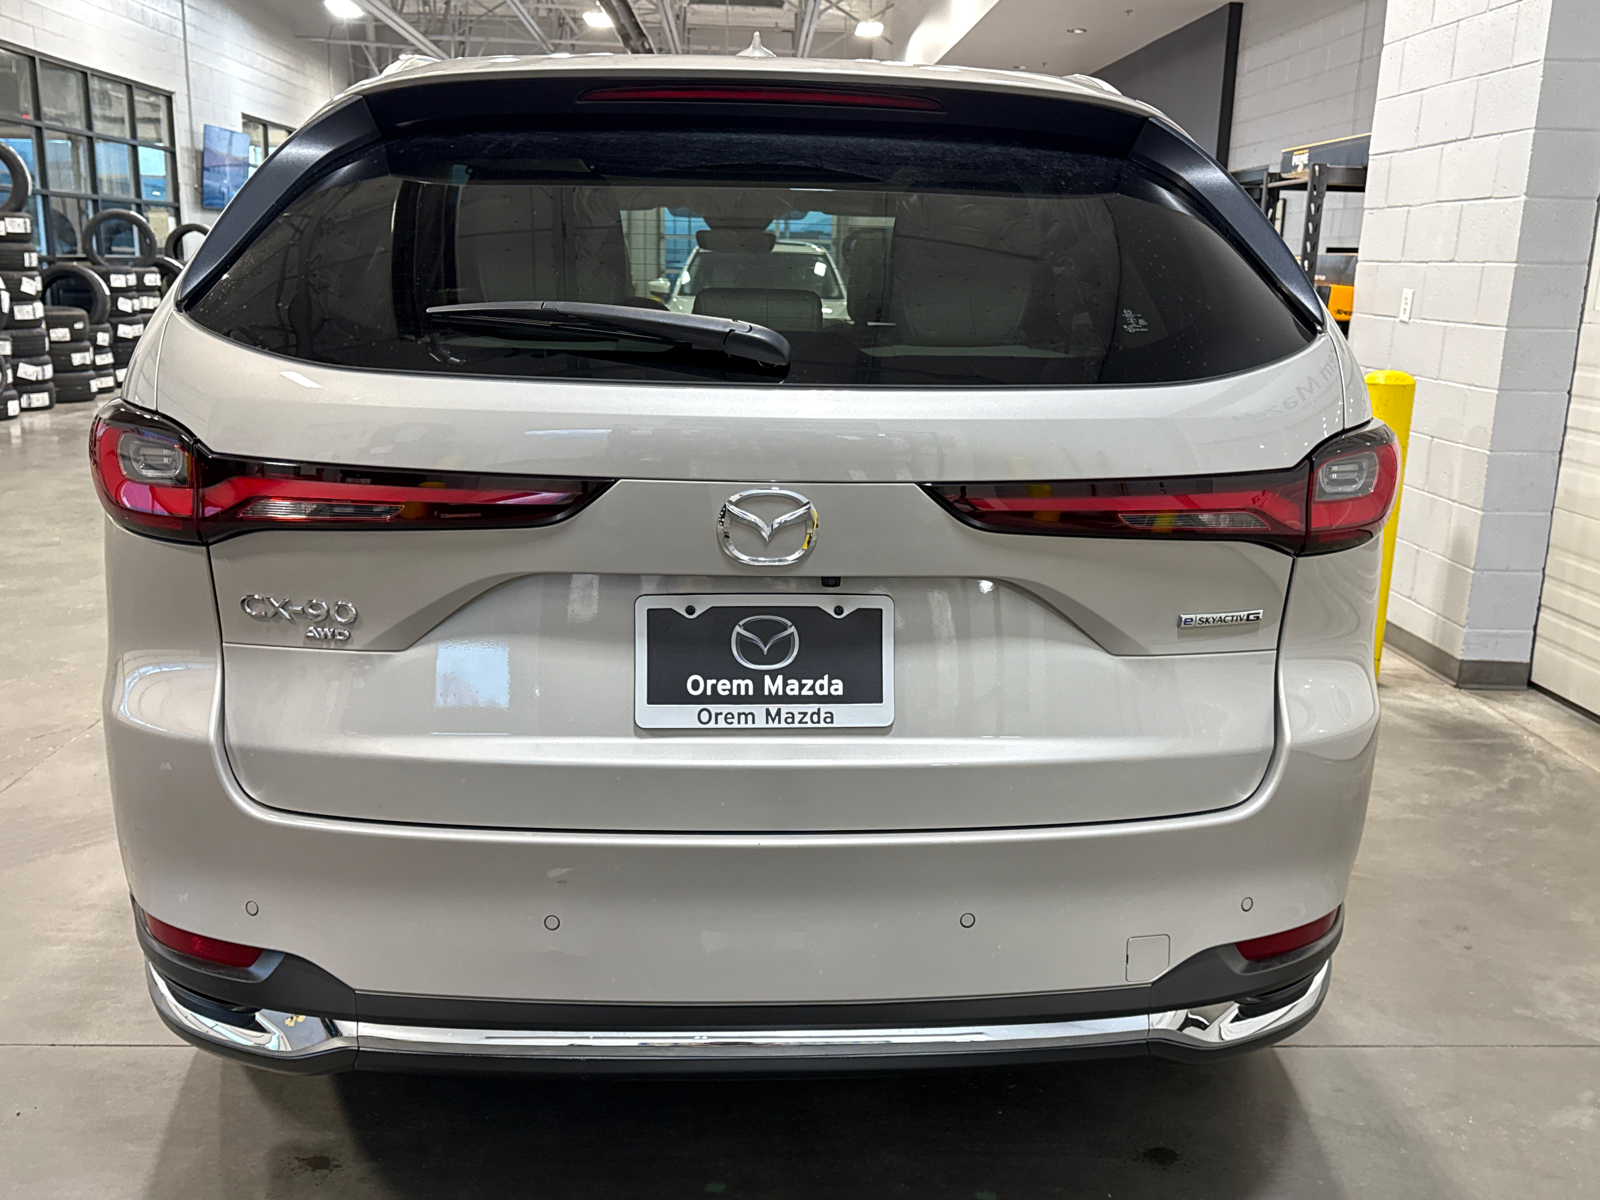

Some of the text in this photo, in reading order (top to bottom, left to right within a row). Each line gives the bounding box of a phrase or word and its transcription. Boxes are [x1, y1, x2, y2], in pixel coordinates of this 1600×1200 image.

[240, 594, 357, 624] CX-90
[306, 626, 350, 640] AWD
[686, 674, 844, 696] Orem Mazda
[697, 707, 835, 725] Orem Mazda
